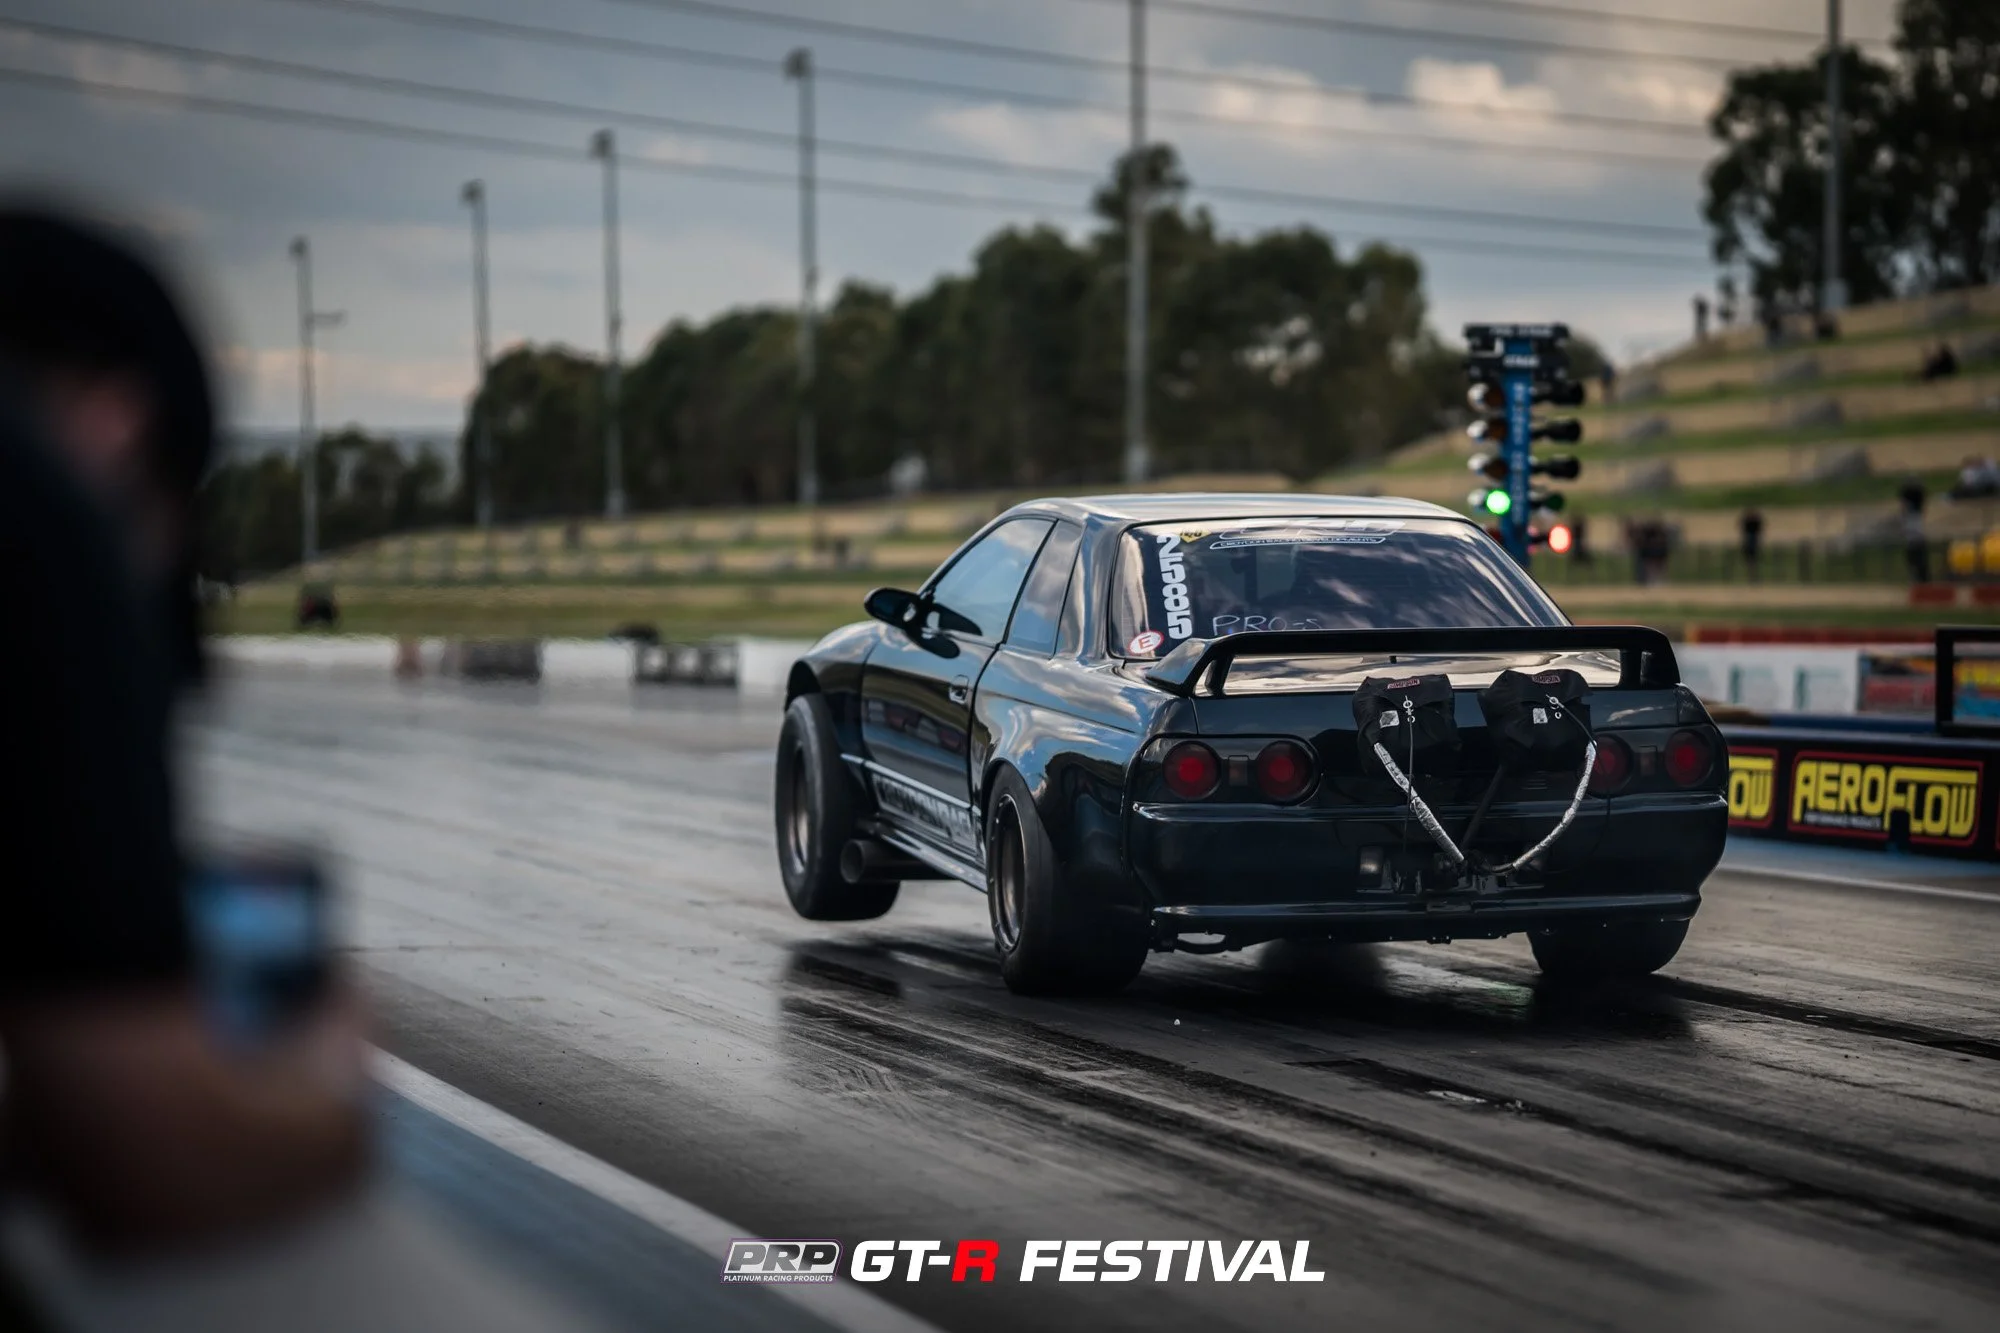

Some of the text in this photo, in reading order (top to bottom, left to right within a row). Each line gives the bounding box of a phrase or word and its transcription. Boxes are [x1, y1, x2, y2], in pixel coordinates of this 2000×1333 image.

[1156, 533, 1193, 640] 2585
[1138, 634, 1153, 650] E
[1792, 760, 1978, 837] AEROFLOW
